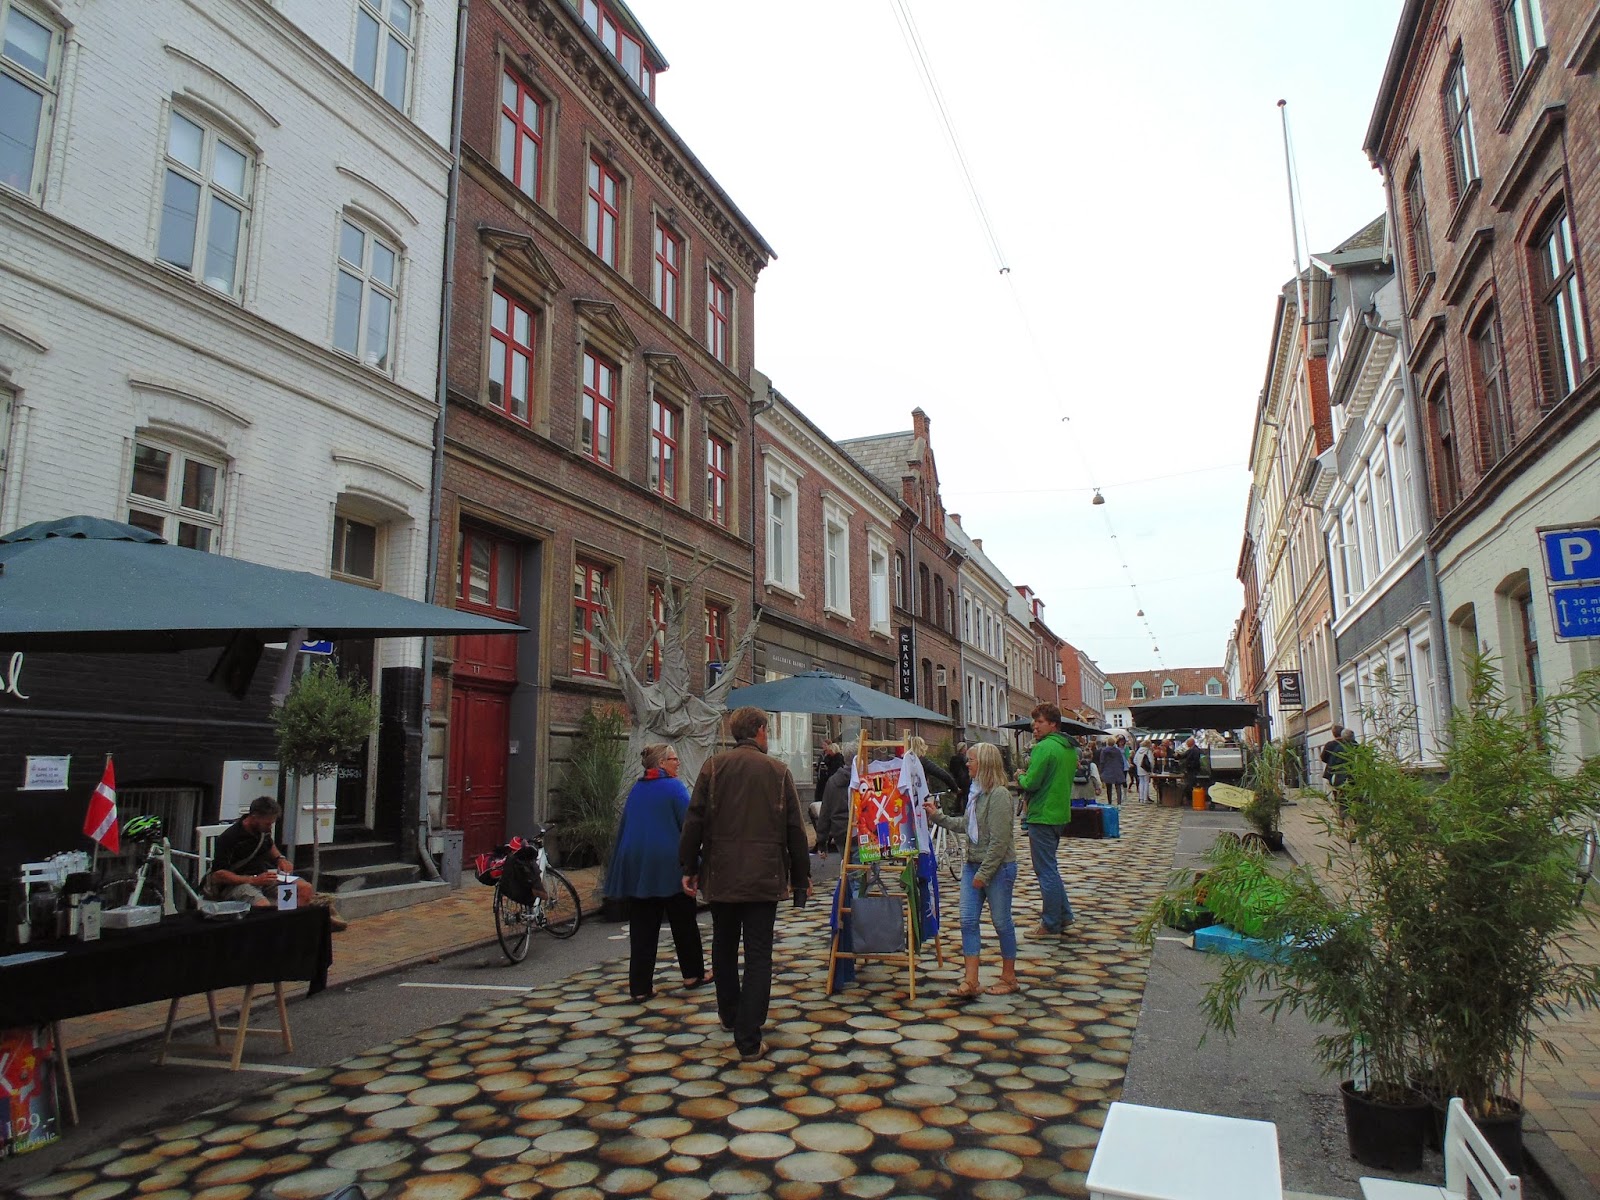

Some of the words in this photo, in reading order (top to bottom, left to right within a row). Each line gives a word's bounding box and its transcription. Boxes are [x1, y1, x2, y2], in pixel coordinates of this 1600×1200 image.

[1559, 537, 1592, 576] P
[1572, 598, 1586, 606] 30
[473, 665, 479, 673] 11
[902, 644, 911, 693] RASMUS
[861, 851, 881, 859] World
